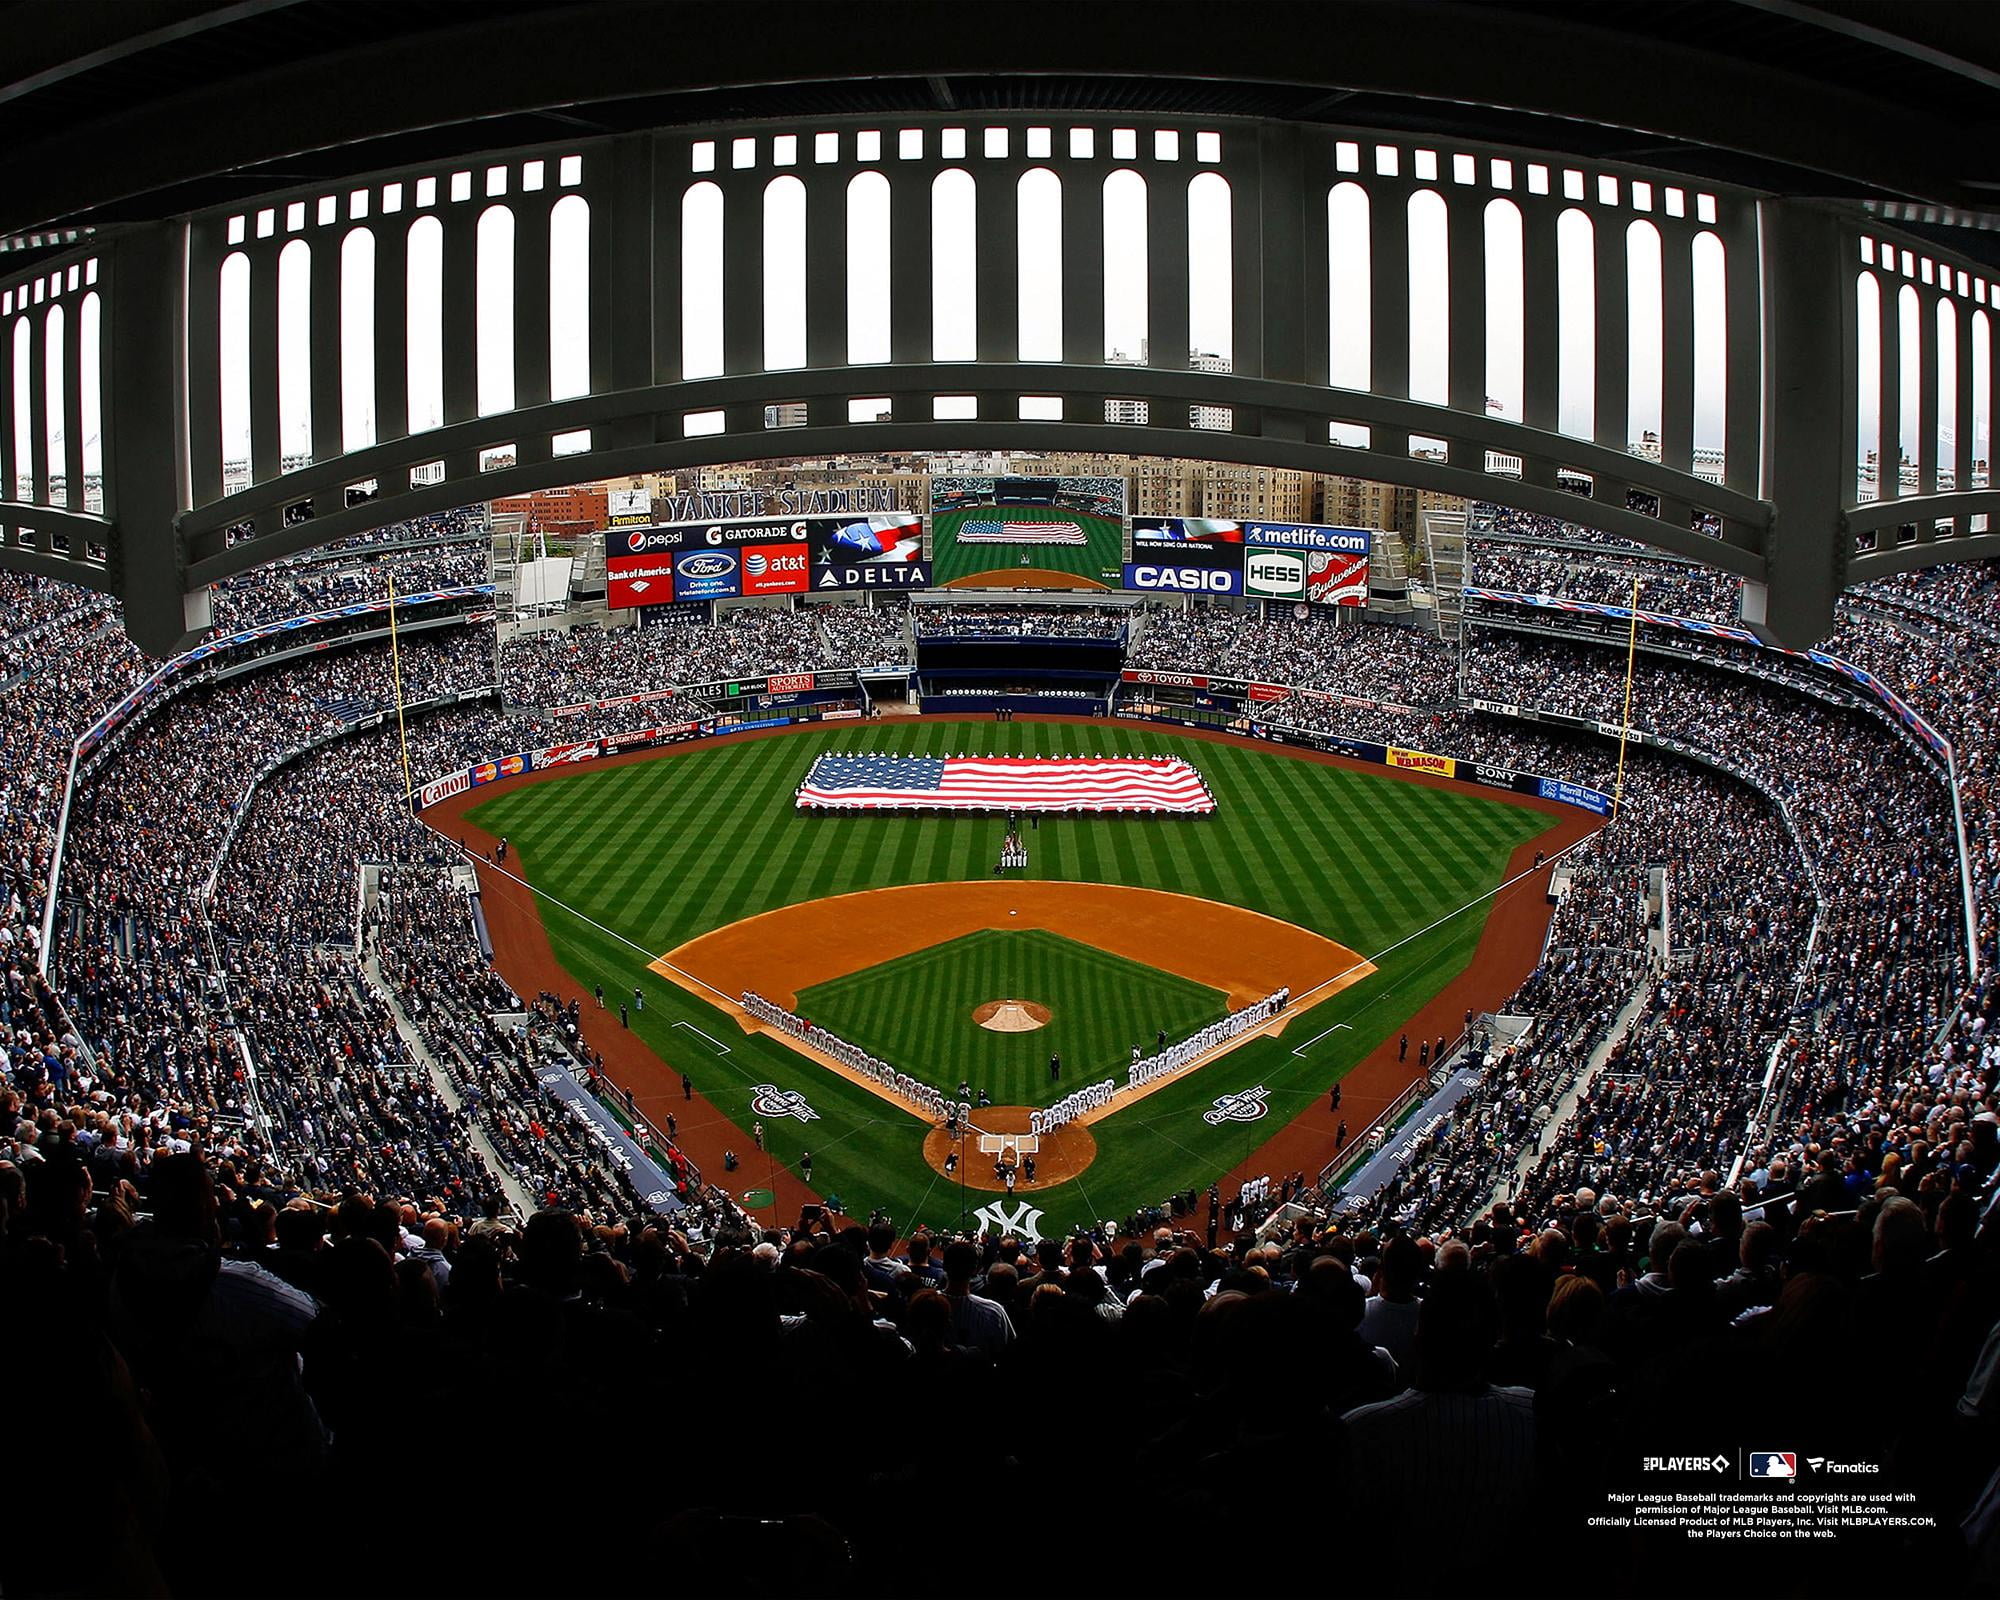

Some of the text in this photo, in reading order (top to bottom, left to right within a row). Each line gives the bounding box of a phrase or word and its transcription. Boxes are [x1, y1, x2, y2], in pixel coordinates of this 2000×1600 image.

[665, 487, 895, 521] YANKEE STADIUM
[612, 515, 650, 526] Armitron
[647, 531, 683, 547] pepsi
[725, 527, 787, 540] GATORADE
[1265, 528, 1365, 550] metlife.com
[691, 559, 723, 574] Ford
[771, 555, 806, 571] at&t
[608, 566, 671, 580] Bank of America
[846, 568, 925, 584] DELTA
[1135, 566, 1232, 592] CASIO
[1250, 564, 1301, 583] HESS
[1307, 556, 1369, 602] Budweiser
[771, 676, 810, 687] SPORTS
[1153, 673, 1194, 685] TOYOTA
[688, 685, 721, 698] ZALES
[771, 683, 810, 692] AUTHORITY
[540, 742, 588, 769] Budweiser
[1476, 765, 1517, 782] SONY
[422, 774, 469, 805] Canon
[973, 1200, 1045, 1245] NY
